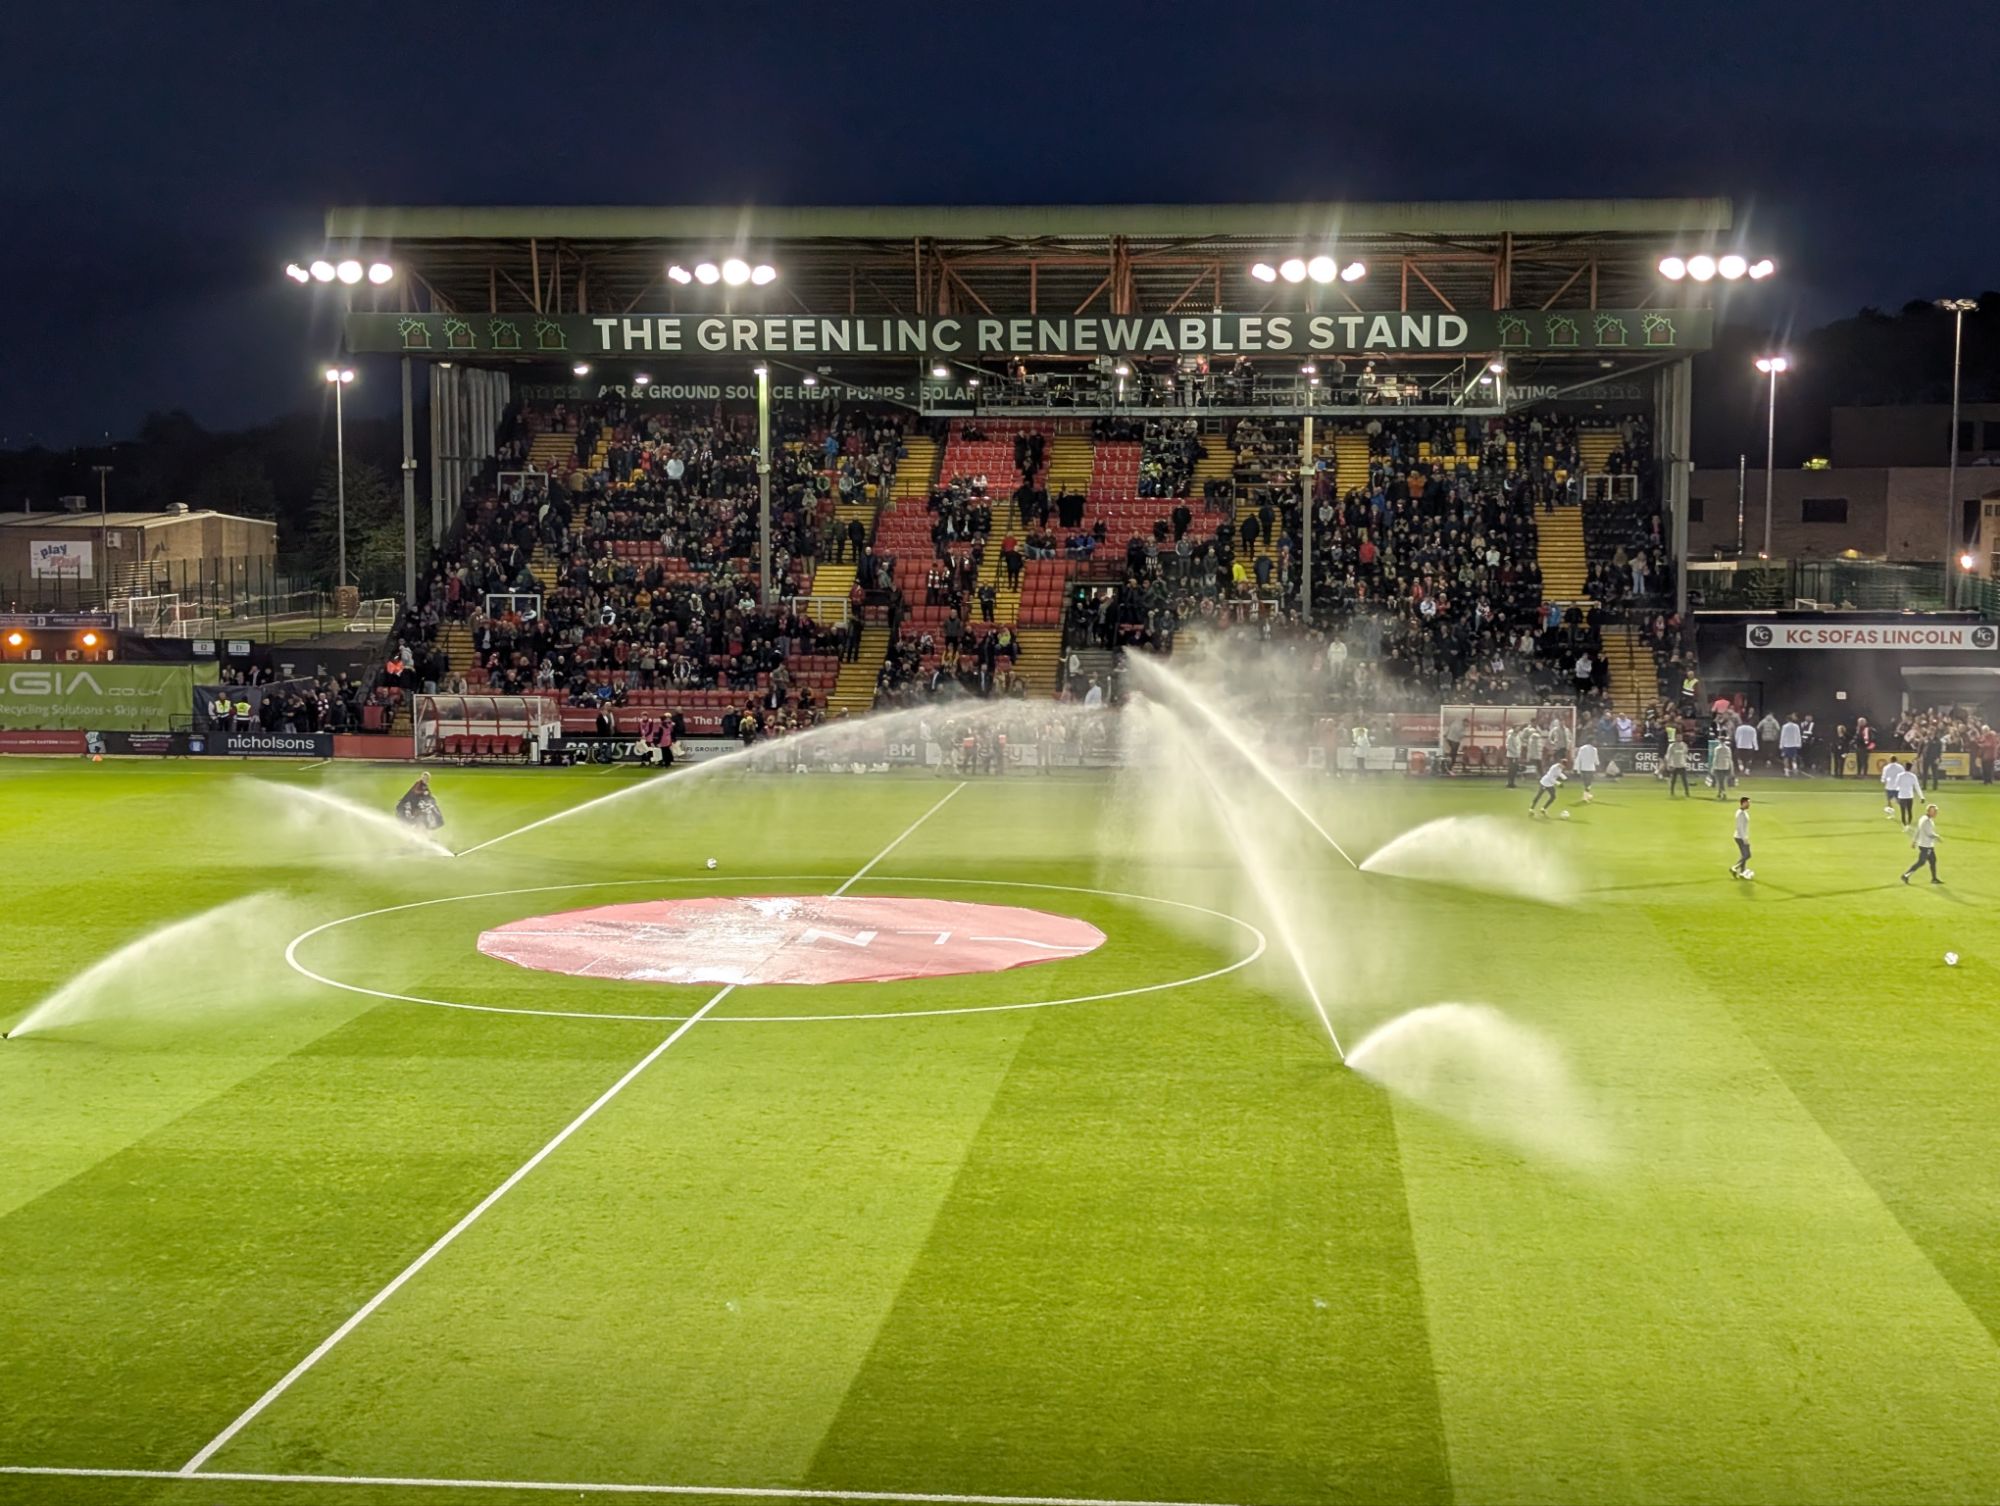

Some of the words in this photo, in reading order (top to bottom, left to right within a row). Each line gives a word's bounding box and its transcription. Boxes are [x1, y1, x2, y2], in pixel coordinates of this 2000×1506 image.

[592, 318, 682, 351] THE
[697, 318, 962, 352] GREENLINC
[978, 316, 1293, 352] RENEWABLES
[1308, 314, 1469, 349] STAND
[598, 385, 626, 399] AR
[631, 385, 644, 399] &
[649, 385, 721, 399] GROUND
[725, 385, 793, 399] SOUCE
[798, 385, 842, 399] HEAT
[922, 386, 976, 400] SOLAR
[1481, 385, 1559, 400] HATING
[40, 544, 67, 559] play
[1786, 630, 1813, 643] KC
[1817, 630, 1878, 644] SOFAS
[1883, 630, 1962, 644] LINCOLN
[52, 704, 102, 716] Solutions
[114, 704, 138, 717] Skip
[693, 716, 712, 726] The
[227, 734, 315, 750] nicholsons
